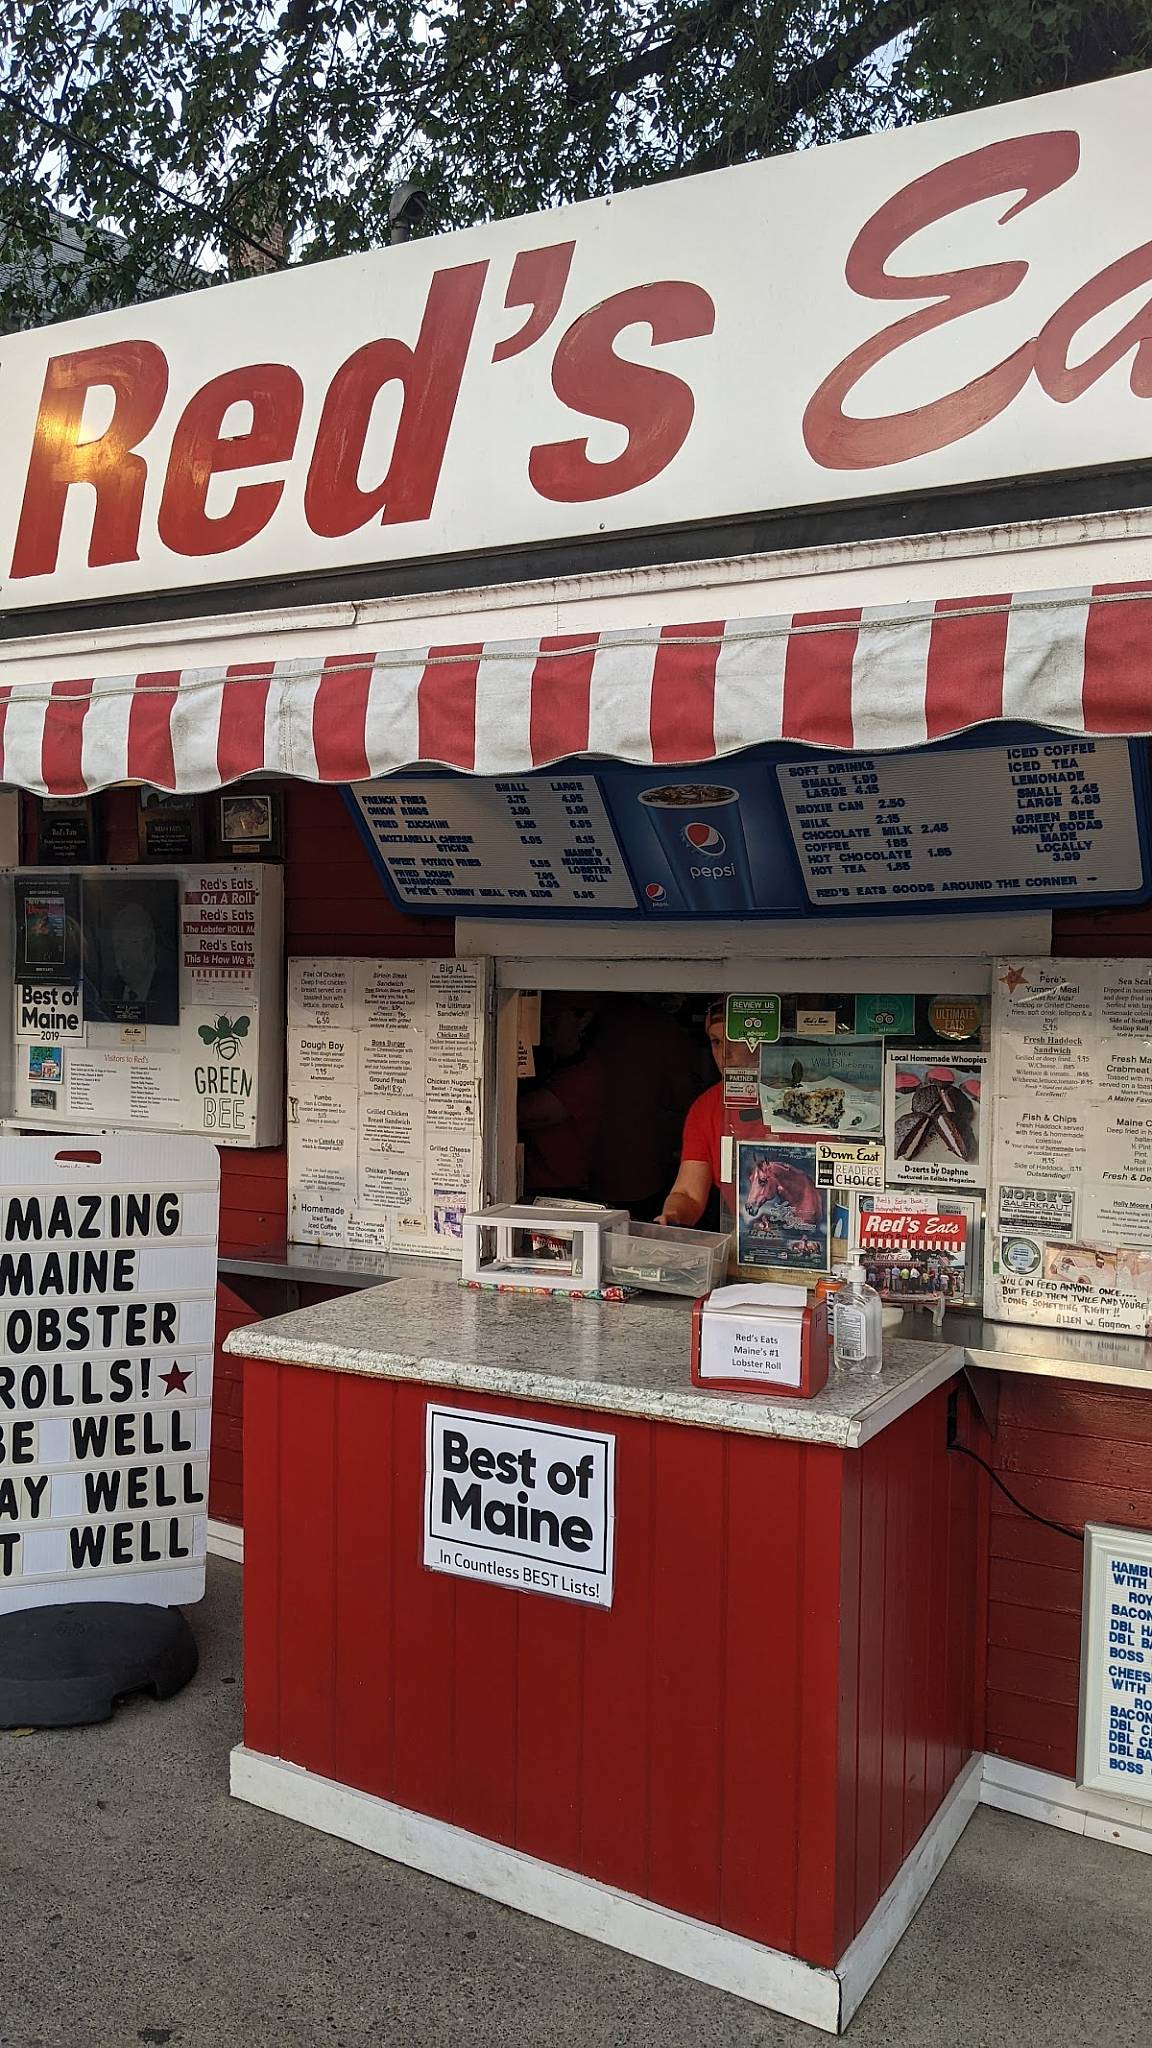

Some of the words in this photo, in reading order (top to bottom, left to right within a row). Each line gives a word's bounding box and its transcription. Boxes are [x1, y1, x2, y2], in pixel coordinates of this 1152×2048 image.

[9, 239, 716, 579] Red's
[1007, 747, 1039, 760] ICED
[1044, 743, 1097, 756] COFFEE
[789, 766, 819, 777] SOFT
[828, 761, 875, 775] DRINKS
[1008, 760, 1041, 773] ICED
[1051, 758, 1079, 770] TEA
[801, 777, 842, 788] SMALL
[1011, 771, 1085, 786] LEMONADE
[495, 783, 530, 792] SMALL
[550, 782, 584, 791] LARGE
[805, 787, 847, 798] LARGE
[1017, 786, 1063, 798] SMALL
[795, 803, 833, 814] MOXIE
[838, 801, 864, 812] CAN
[1017, 797, 1063, 809] LARGE
[368, 807, 395, 815] ONION
[1015, 812, 1061, 824] GREEN
[1068, 810, 1095, 821] BEE
[800, 818, 831, 829] MILK
[1012, 823, 1055, 835] HONEY
[1059, 820, 1104, 831] SODAS
[802, 828, 872, 840] CHOCOLATE
[882, 825, 913, 836] MILK
[1040, 832, 1078, 843] MADE
[805, 842, 851, 852] COFFEE
[1036, 841, 1093, 853] LOCALLY
[421, 858, 454, 866] POTATO
[808, 854, 831, 864] HOT
[839, 850, 913, 862] CHOCOLATE
[690, 862, 737, 880] pepsi
[811, 866, 833, 875] HOT
[842, 864, 867, 873] TEA
[200, 878, 228, 890] Red's
[231, 878, 253, 889] Eats
[816, 888, 850, 898] RED'S
[856, 885, 887, 896] EATS
[892, 883, 935, 894] GOODS
[941, 878, 993, 892] AROUND
[995, 878, 1021, 889] THE
[1025, 876, 1078, 887] CORNER
[201, 892, 217, 904] On
[220, 892, 229, 904] A
[231, 892, 252, 904] Roll
[200, 909, 229, 921] Red's
[231, 909, 254, 921] Eats
[200, 939, 228, 951] Red's
[230, 940, 253, 951] Eats
[186, 954, 201, 964] This
[211, 954, 230, 965] How
[440, 963, 454, 974] Big
[22, 986, 58, 1006] Best
[61, 986, 79, 1006] of
[733, 1001, 762, 1009] REVIEW
[764, 1001, 775, 1009] US
[21, 1006, 79, 1030] Maine
[935, 1009, 976, 1020] ULTIMATE
[945, 1020, 965, 1030] EATS
[40, 1031, 60, 1041] 2019
[1047, 1036, 1083, 1045] Haddock
[300, 1040, 326, 1050] Dough
[328, 1041, 345, 1051] Boy
[910, 1054, 950, 1063] Homemade
[951, 1055, 987, 1064] Whoopies
[1111, 1054, 1137, 1063] Fresh
[1106, 1064, 1150, 1074] Crabmeat
[195, 1066, 253, 1097] GREEN
[204, 1097, 246, 1129] BEE
[1022, 1113, 1042, 1121] Fish
[1052, 1115, 1077, 1123] Chips
[1116, 1118, 1143, 1127] Maine
[820, 1146, 855, 1160] Down
[856, 1148, 880, 1162] East
[930, 1166, 940, 1175] by
[941, 1167, 969, 1177] Daphne
[1102, 1171, 1128, 1181] Fresh
[836, 1174, 882, 1187] CHOICE
[1001, 1187, 1073, 1204] MORSE'S
[301, 1203, 345, 1215] Homemade
[1003, 1199, 1070, 1211] SAUERKRAUT
[5, 1192, 181, 1241] MAZING
[865, 1215, 920, 1233] Red's
[924, 1217, 961, 1235] Eats
[0, 1249, 136, 1296] MAINE
[6, 1302, 177, 1354] OBSTER
[735, 1334, 758, 1342] Red's
[760, 1335, 778, 1344] Eats
[734, 1346, 767, 1356] Maine's
[769, 1349, 779, 1357] #1
[732, 1359, 763, 1368] Lobster
[765, 1361, 781, 1370] Roll
[0, 1358, 151, 1410] ROLLS!
[72, 1410, 192, 1460] WELL
[443, 1429, 536, 1489] Best
[547, 1455, 593, 1499] of
[84, 1462, 204, 1514] WELL
[441, 1477, 593, 1553] Maine
[70, 1517, 189, 1569] WELL
[440, 1549, 451, 1565] In
[454, 1553, 519, 1580] Countless
[523, 1567, 558, 1589] BEST
[562, 1576, 600, 1598] Lists!
[1113, 1573, 1147, 1589] WITH
[1110, 1619, 1135, 1633] DBL
[1109, 1631, 1135, 1646] DBL
[1109, 1647, 1144, 1663] BOSS
[1108, 1665, 1152, 1683] CHEES
[1111, 1678, 1146, 1695] WITH
[1110, 1705, 1152, 1724] BACON
[1110, 1718, 1135, 1732] DBL
[1109, 1730, 1134, 1745] DBL
[1109, 1742, 1134, 1757] DBL
[1109, 1758, 1144, 1775] BOSS
